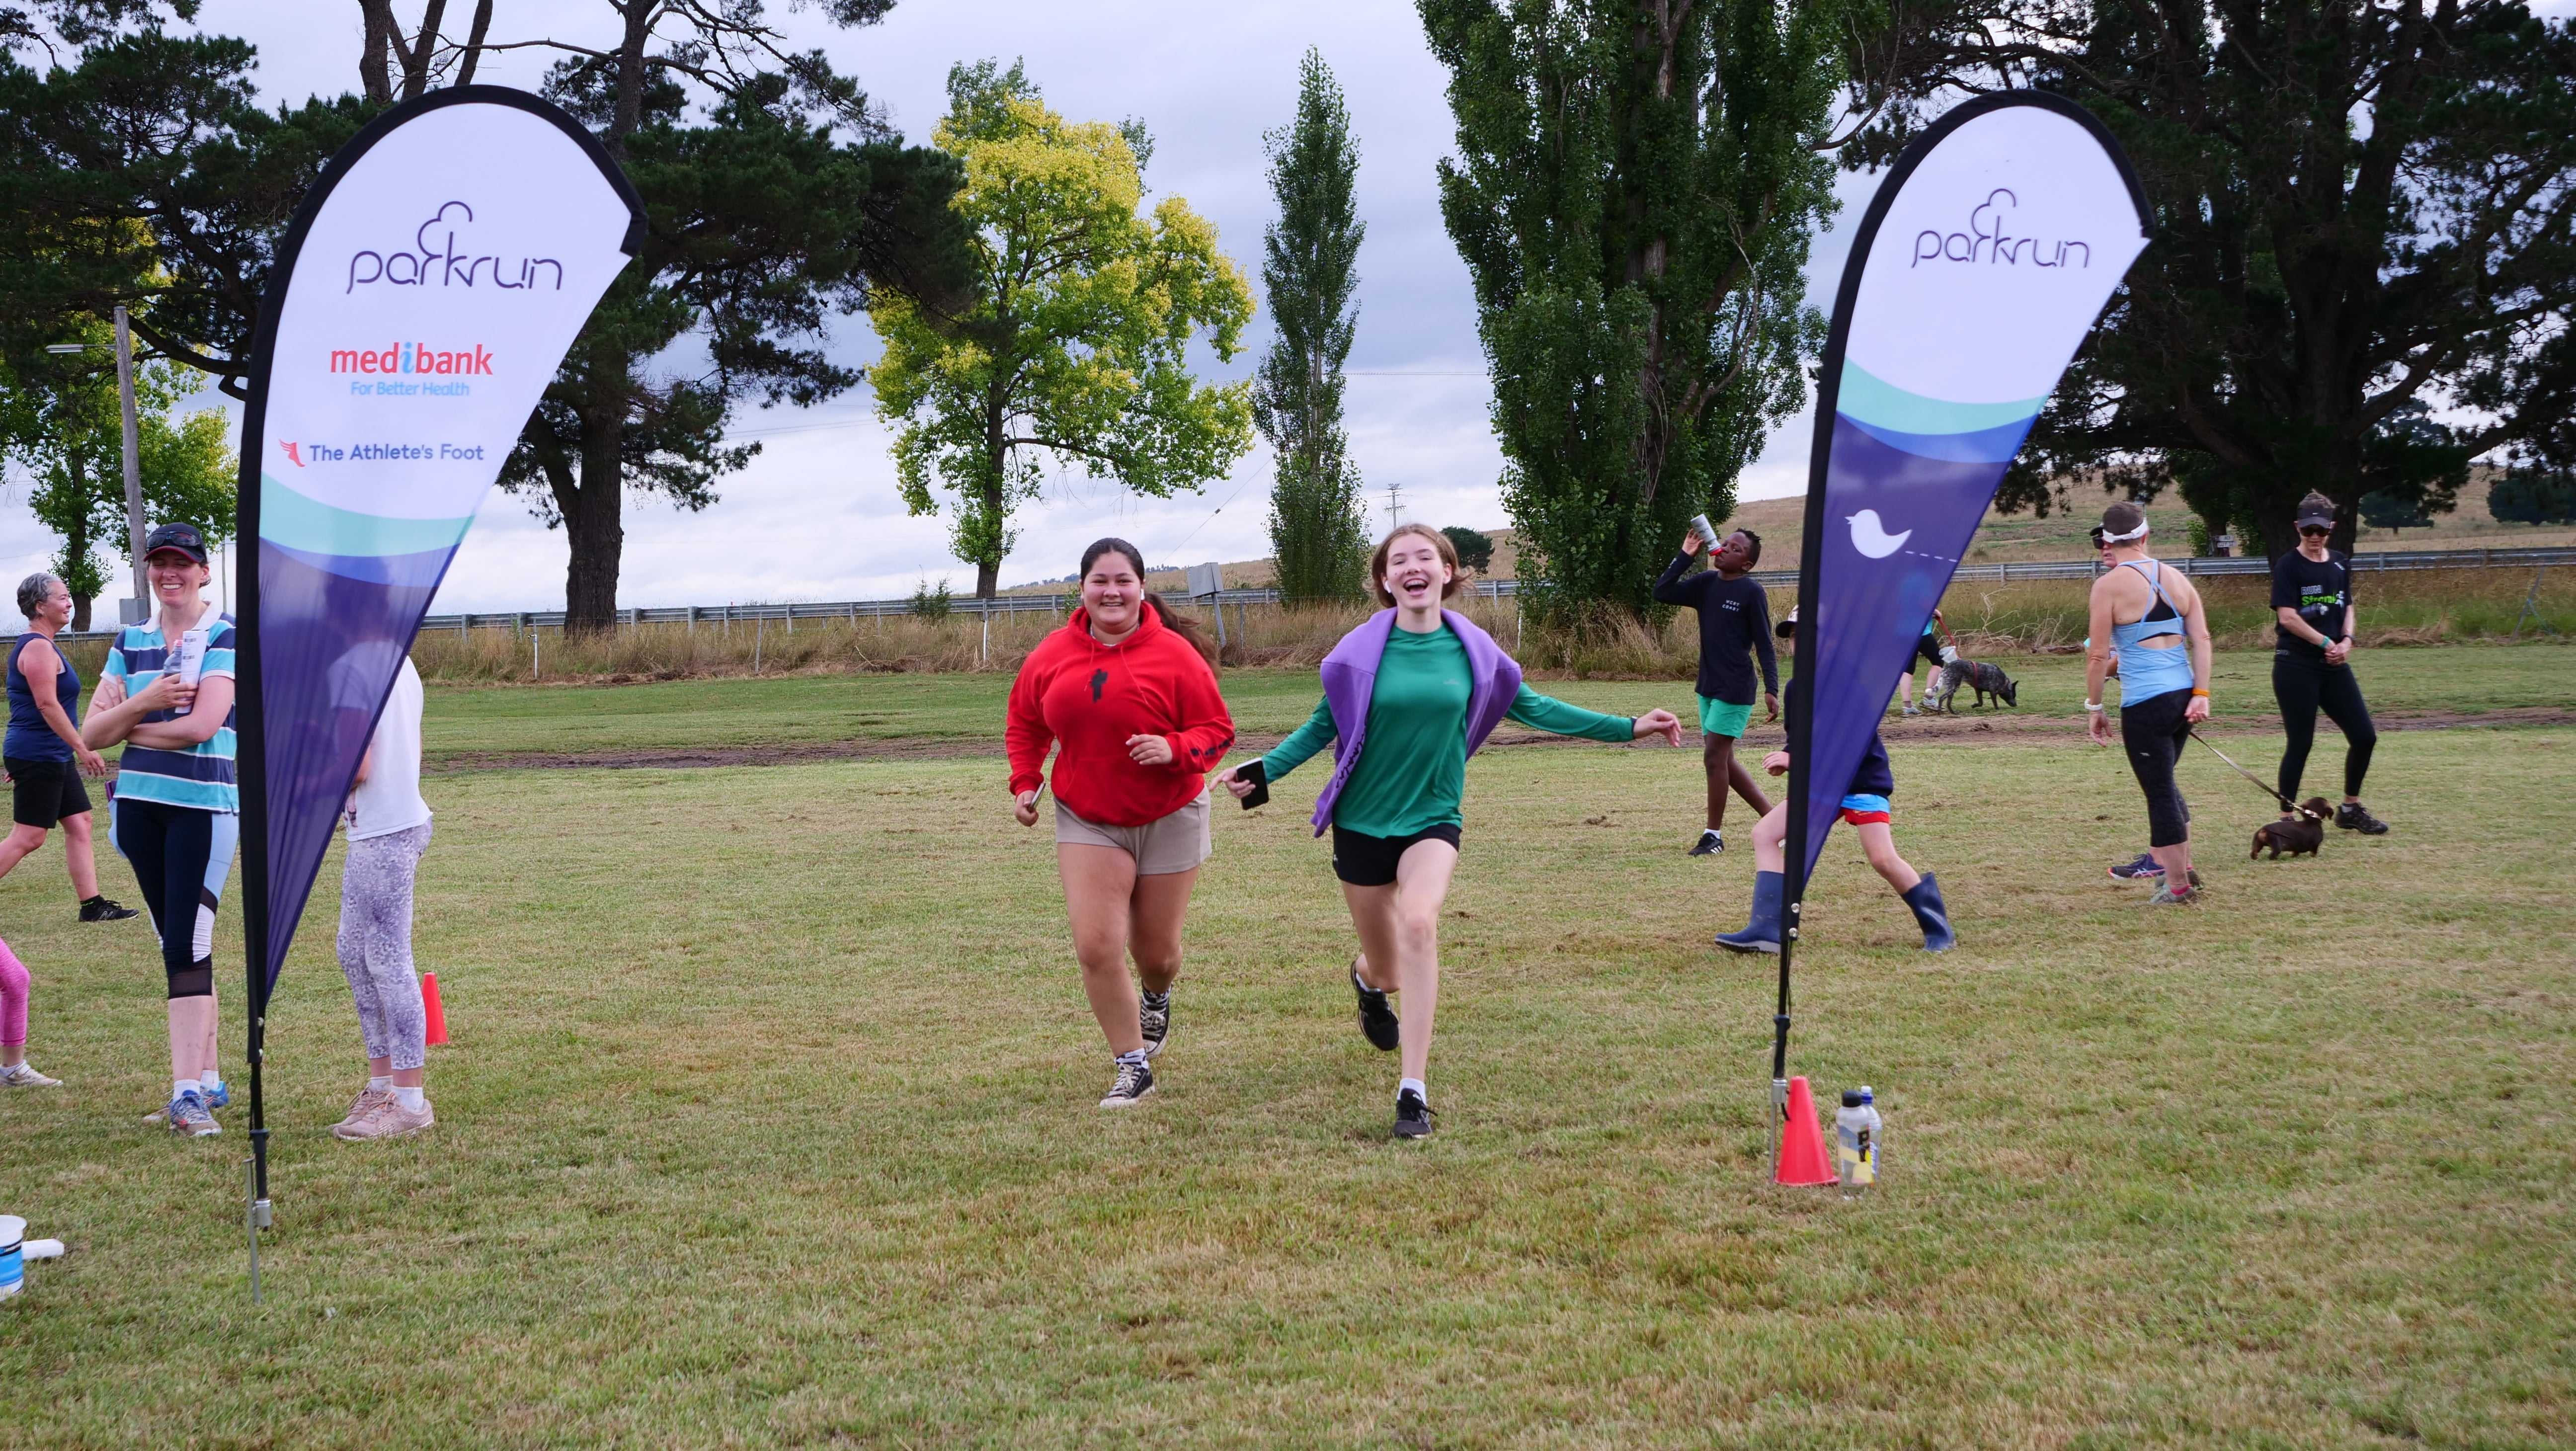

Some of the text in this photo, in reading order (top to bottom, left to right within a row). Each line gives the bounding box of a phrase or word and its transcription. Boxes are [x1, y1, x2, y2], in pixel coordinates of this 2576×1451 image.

[1911, 188, 2090, 268] parkrun
[346, 201, 563, 294] parkrun
[330, 342, 493, 375] medibank
[351, 381, 470, 396] For Better Health
[309, 444, 484, 461] The Athlete's Foot
[2301, 585, 2322, 595] RUN
